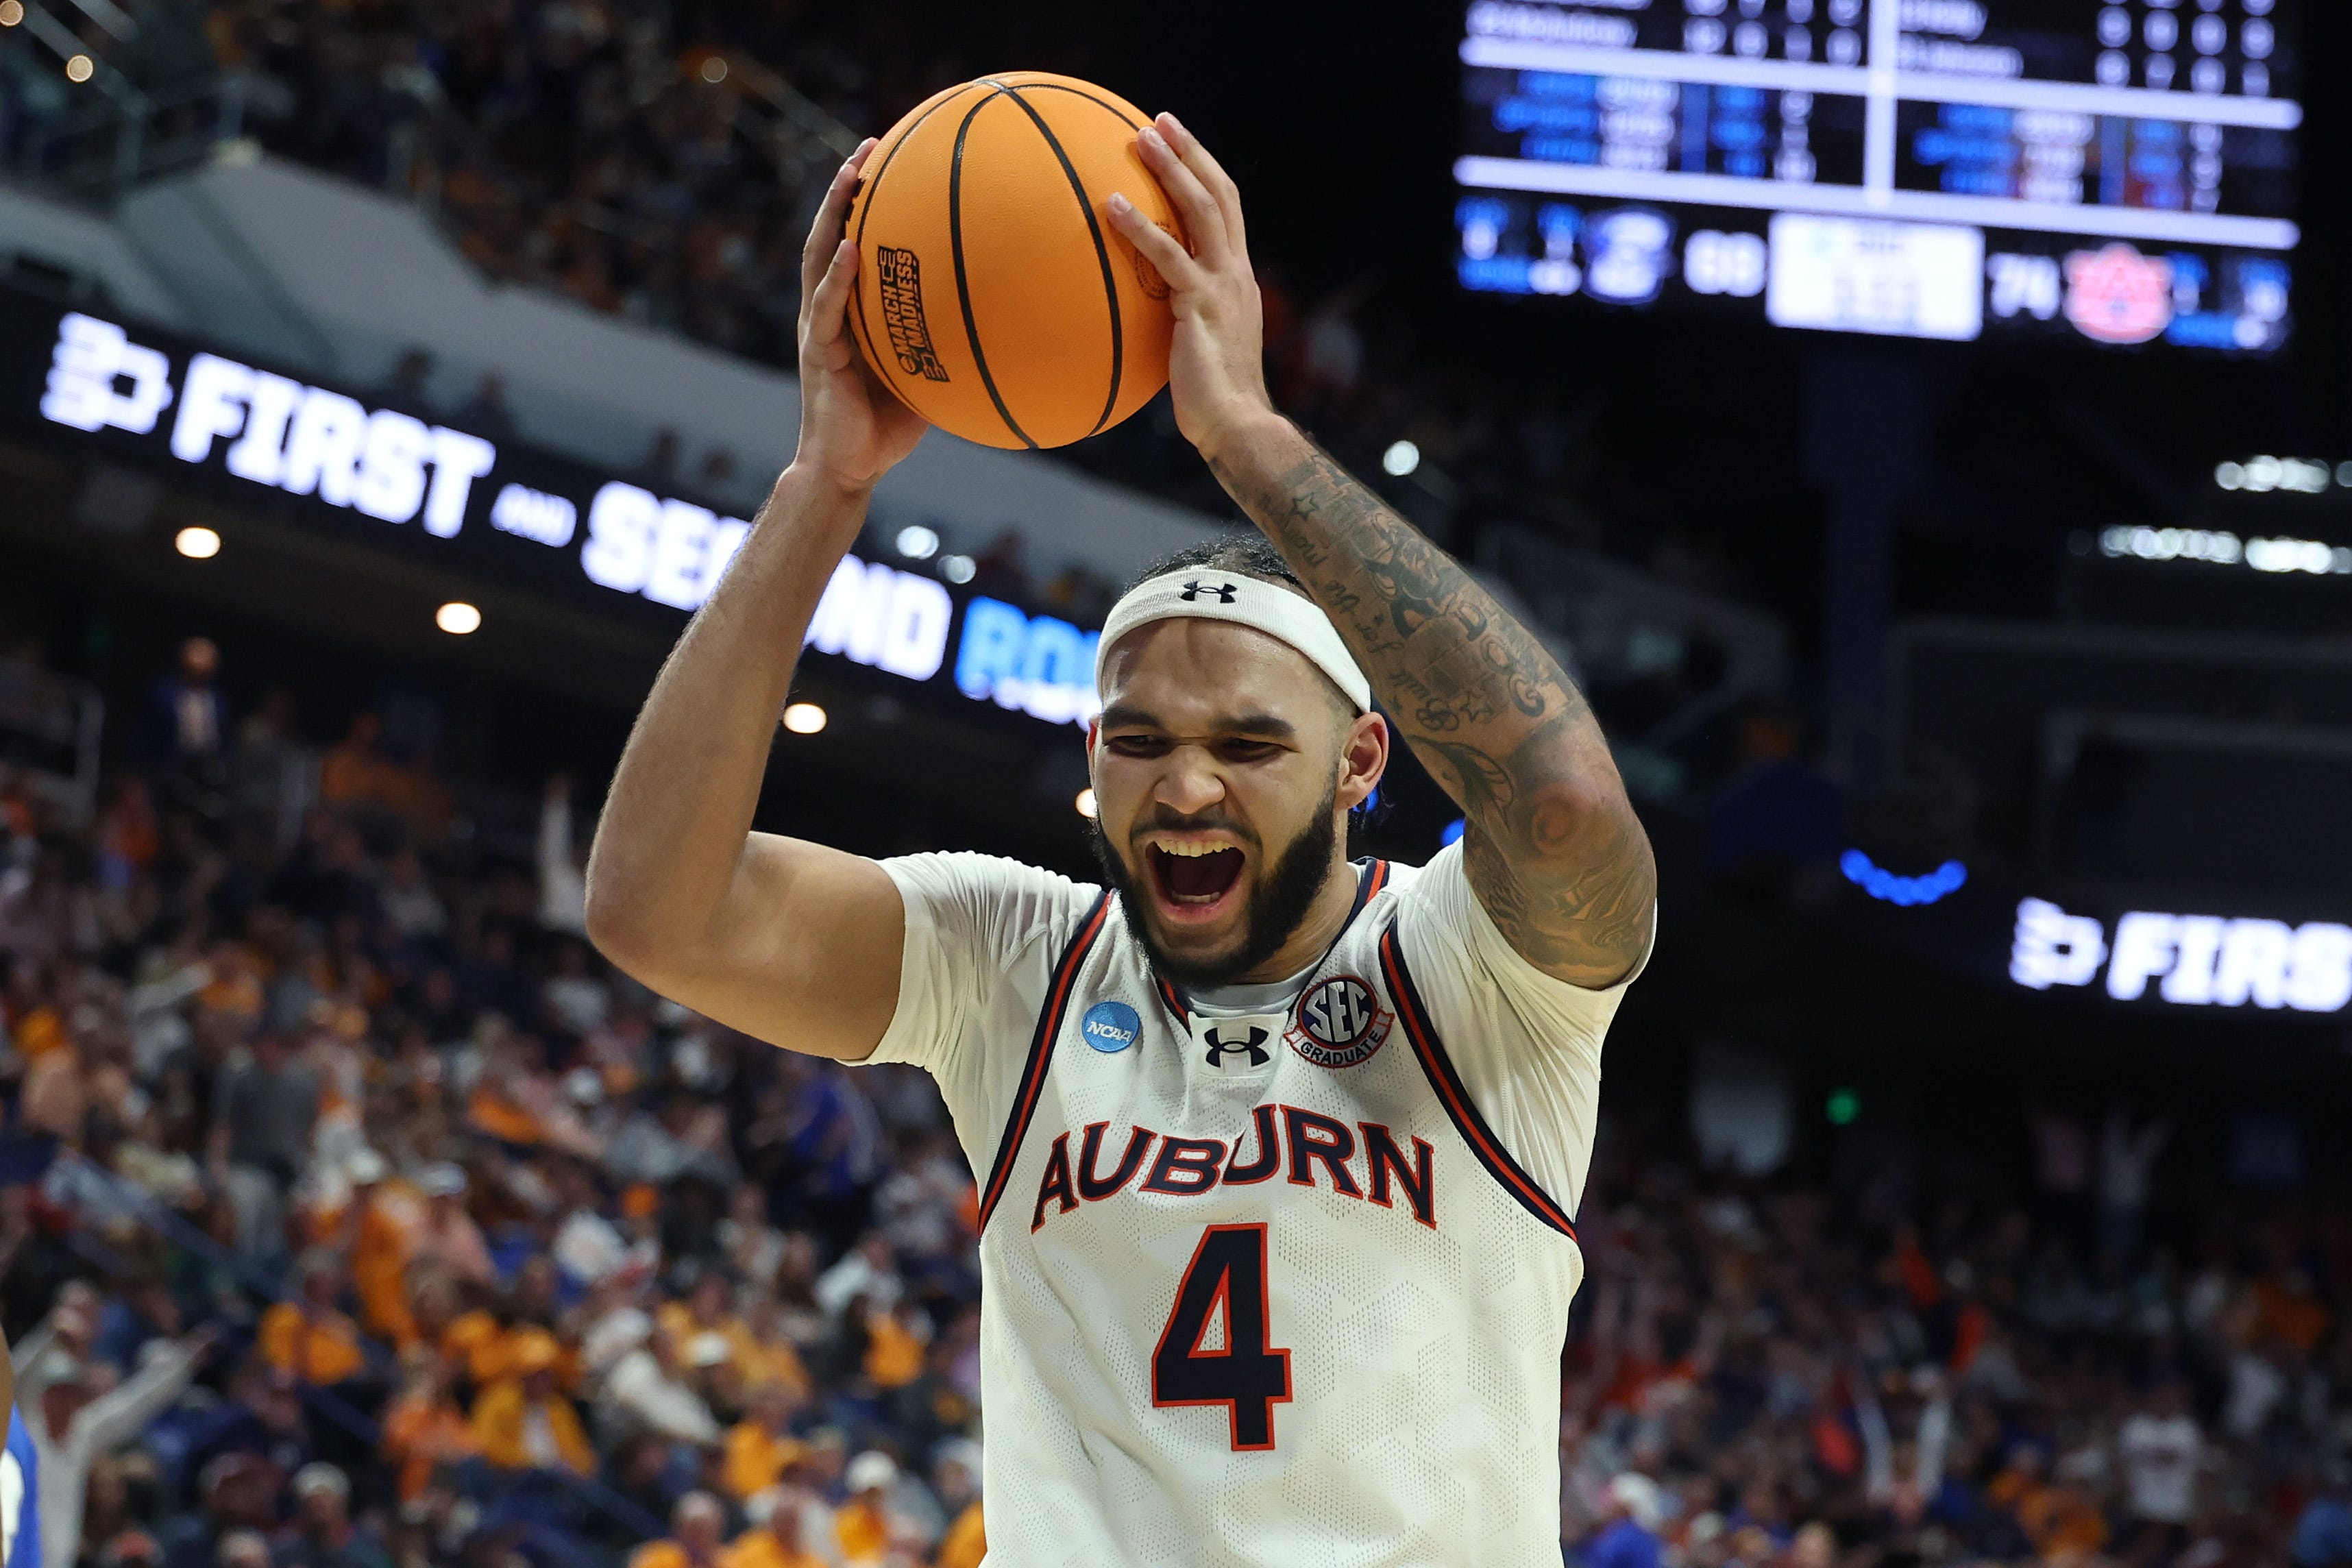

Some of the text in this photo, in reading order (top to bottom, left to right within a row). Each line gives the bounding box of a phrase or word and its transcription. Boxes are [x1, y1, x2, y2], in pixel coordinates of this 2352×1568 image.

[883, 283, 911, 355] MARCH
[897, 250, 927, 350] MADNESS
[171, 352, 496, 539] FIRST
[580, 480, 953, 681] SEND
[1086, 1021, 1133, 1042] NCAA
[1300, 1029, 1382, 1065] GRADUATE
[1305, 981, 1370, 1043] SEC
[1031, 1104, 1437, 1234] AUBURN
[1151, 1222, 1293, 1451] 4
